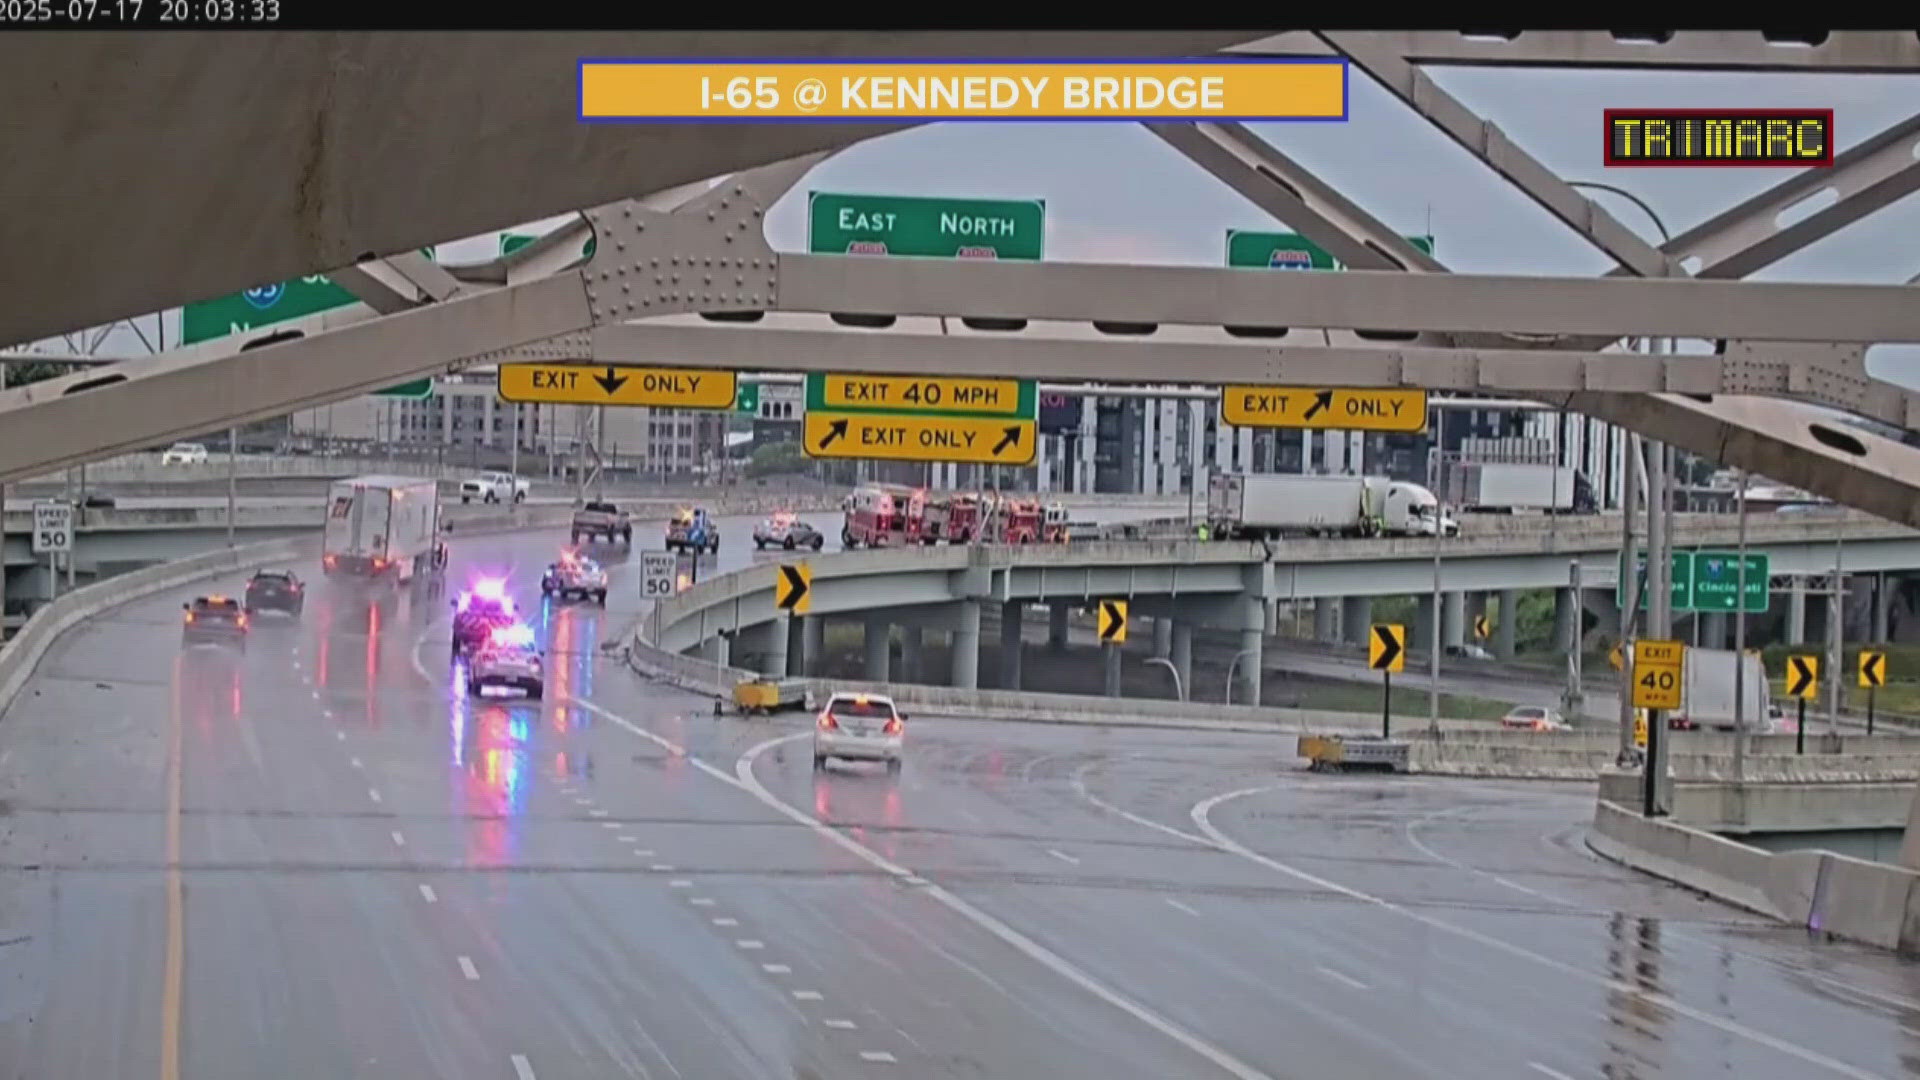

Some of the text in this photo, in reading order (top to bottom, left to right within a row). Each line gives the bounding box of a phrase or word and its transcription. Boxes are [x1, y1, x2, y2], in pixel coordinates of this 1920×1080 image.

[838, 208, 1015, 236] EAST NORTH
[532, 370, 701, 393] EXIT ONLY
[844, 381, 999, 405] EXIT 40 MPH
[1243, 395, 1404, 418] EXIT ONLY
[861, 427, 978, 448] EXIT ONLY
[41, 531, 66, 547] 50
[647, 579, 670, 594] 50
[1698, 581, 1761, 594] Cincinati
[1645, 647, 1671, 658] EXIT
[1640, 671, 1674, 690] 40
